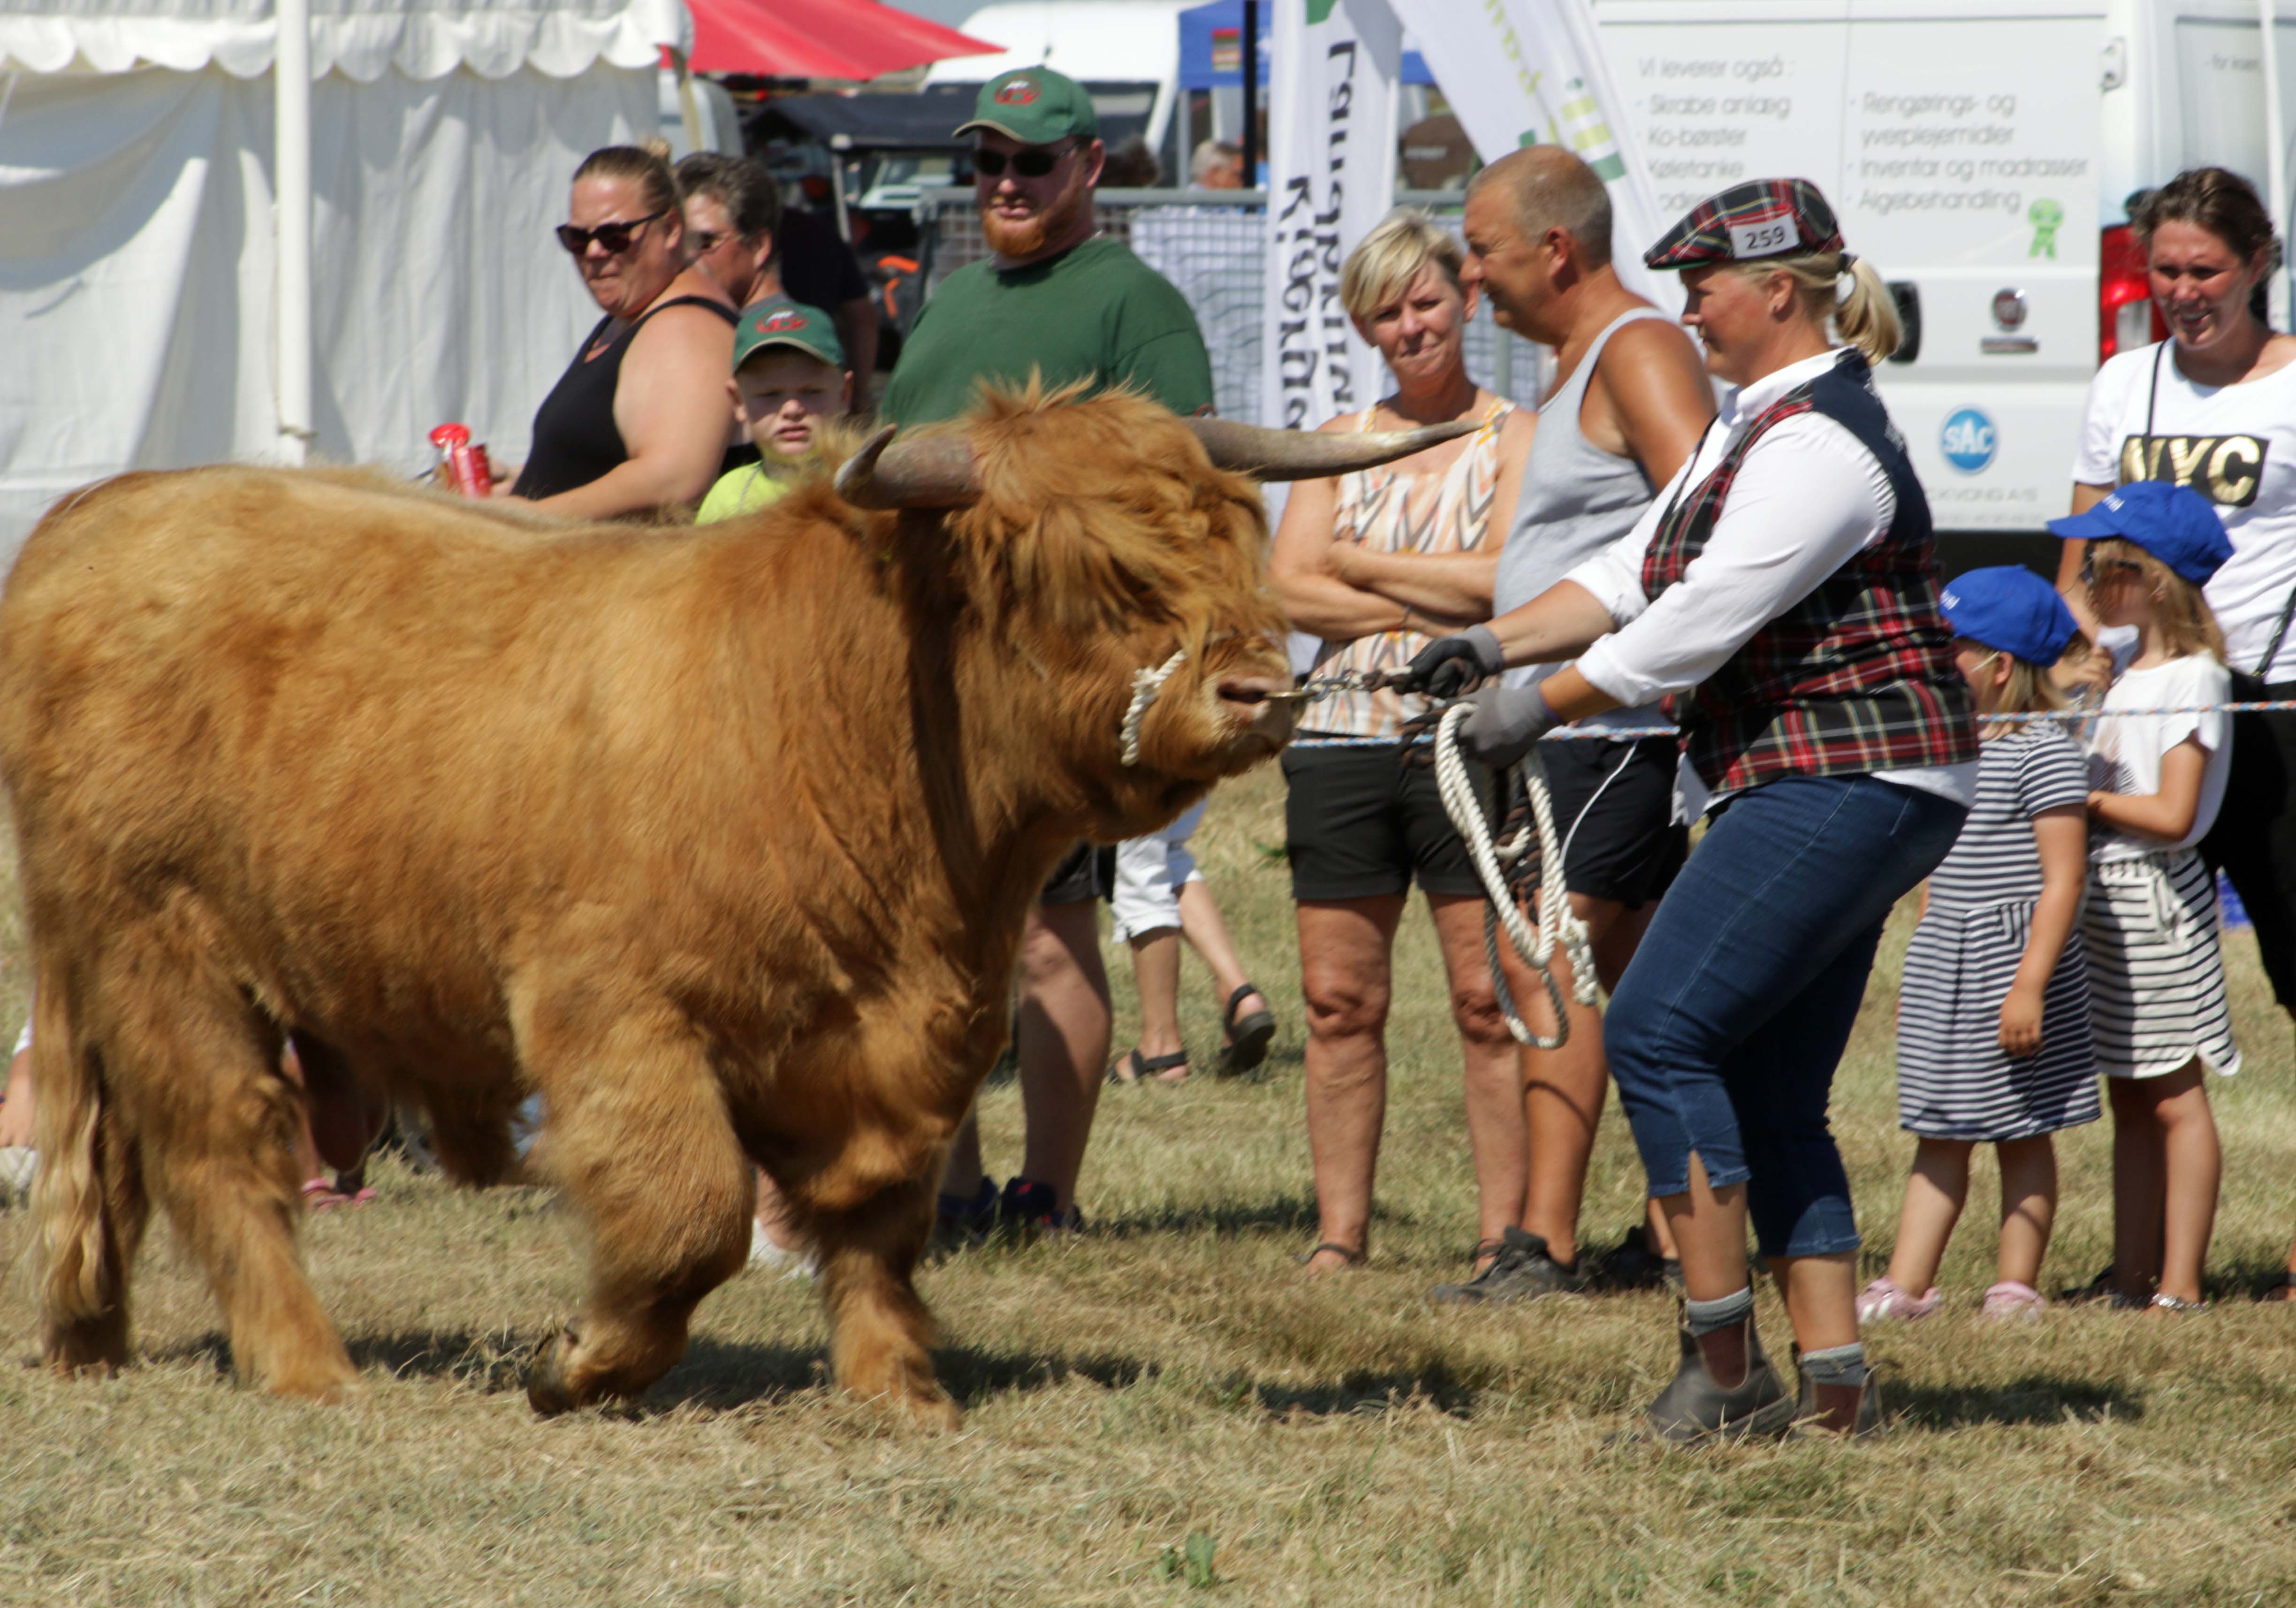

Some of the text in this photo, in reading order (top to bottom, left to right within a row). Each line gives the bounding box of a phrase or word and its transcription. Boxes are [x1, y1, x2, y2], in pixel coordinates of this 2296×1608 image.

[1661, 57, 1726, 78] leverer
[1986, 92, 2017, 118] og
[1946, 158, 1974, 183] og
[1745, 225, 1786, 250] 259
[1944, 418, 1994, 454] SAC
[2121, 435, 2260, 503] NYC
